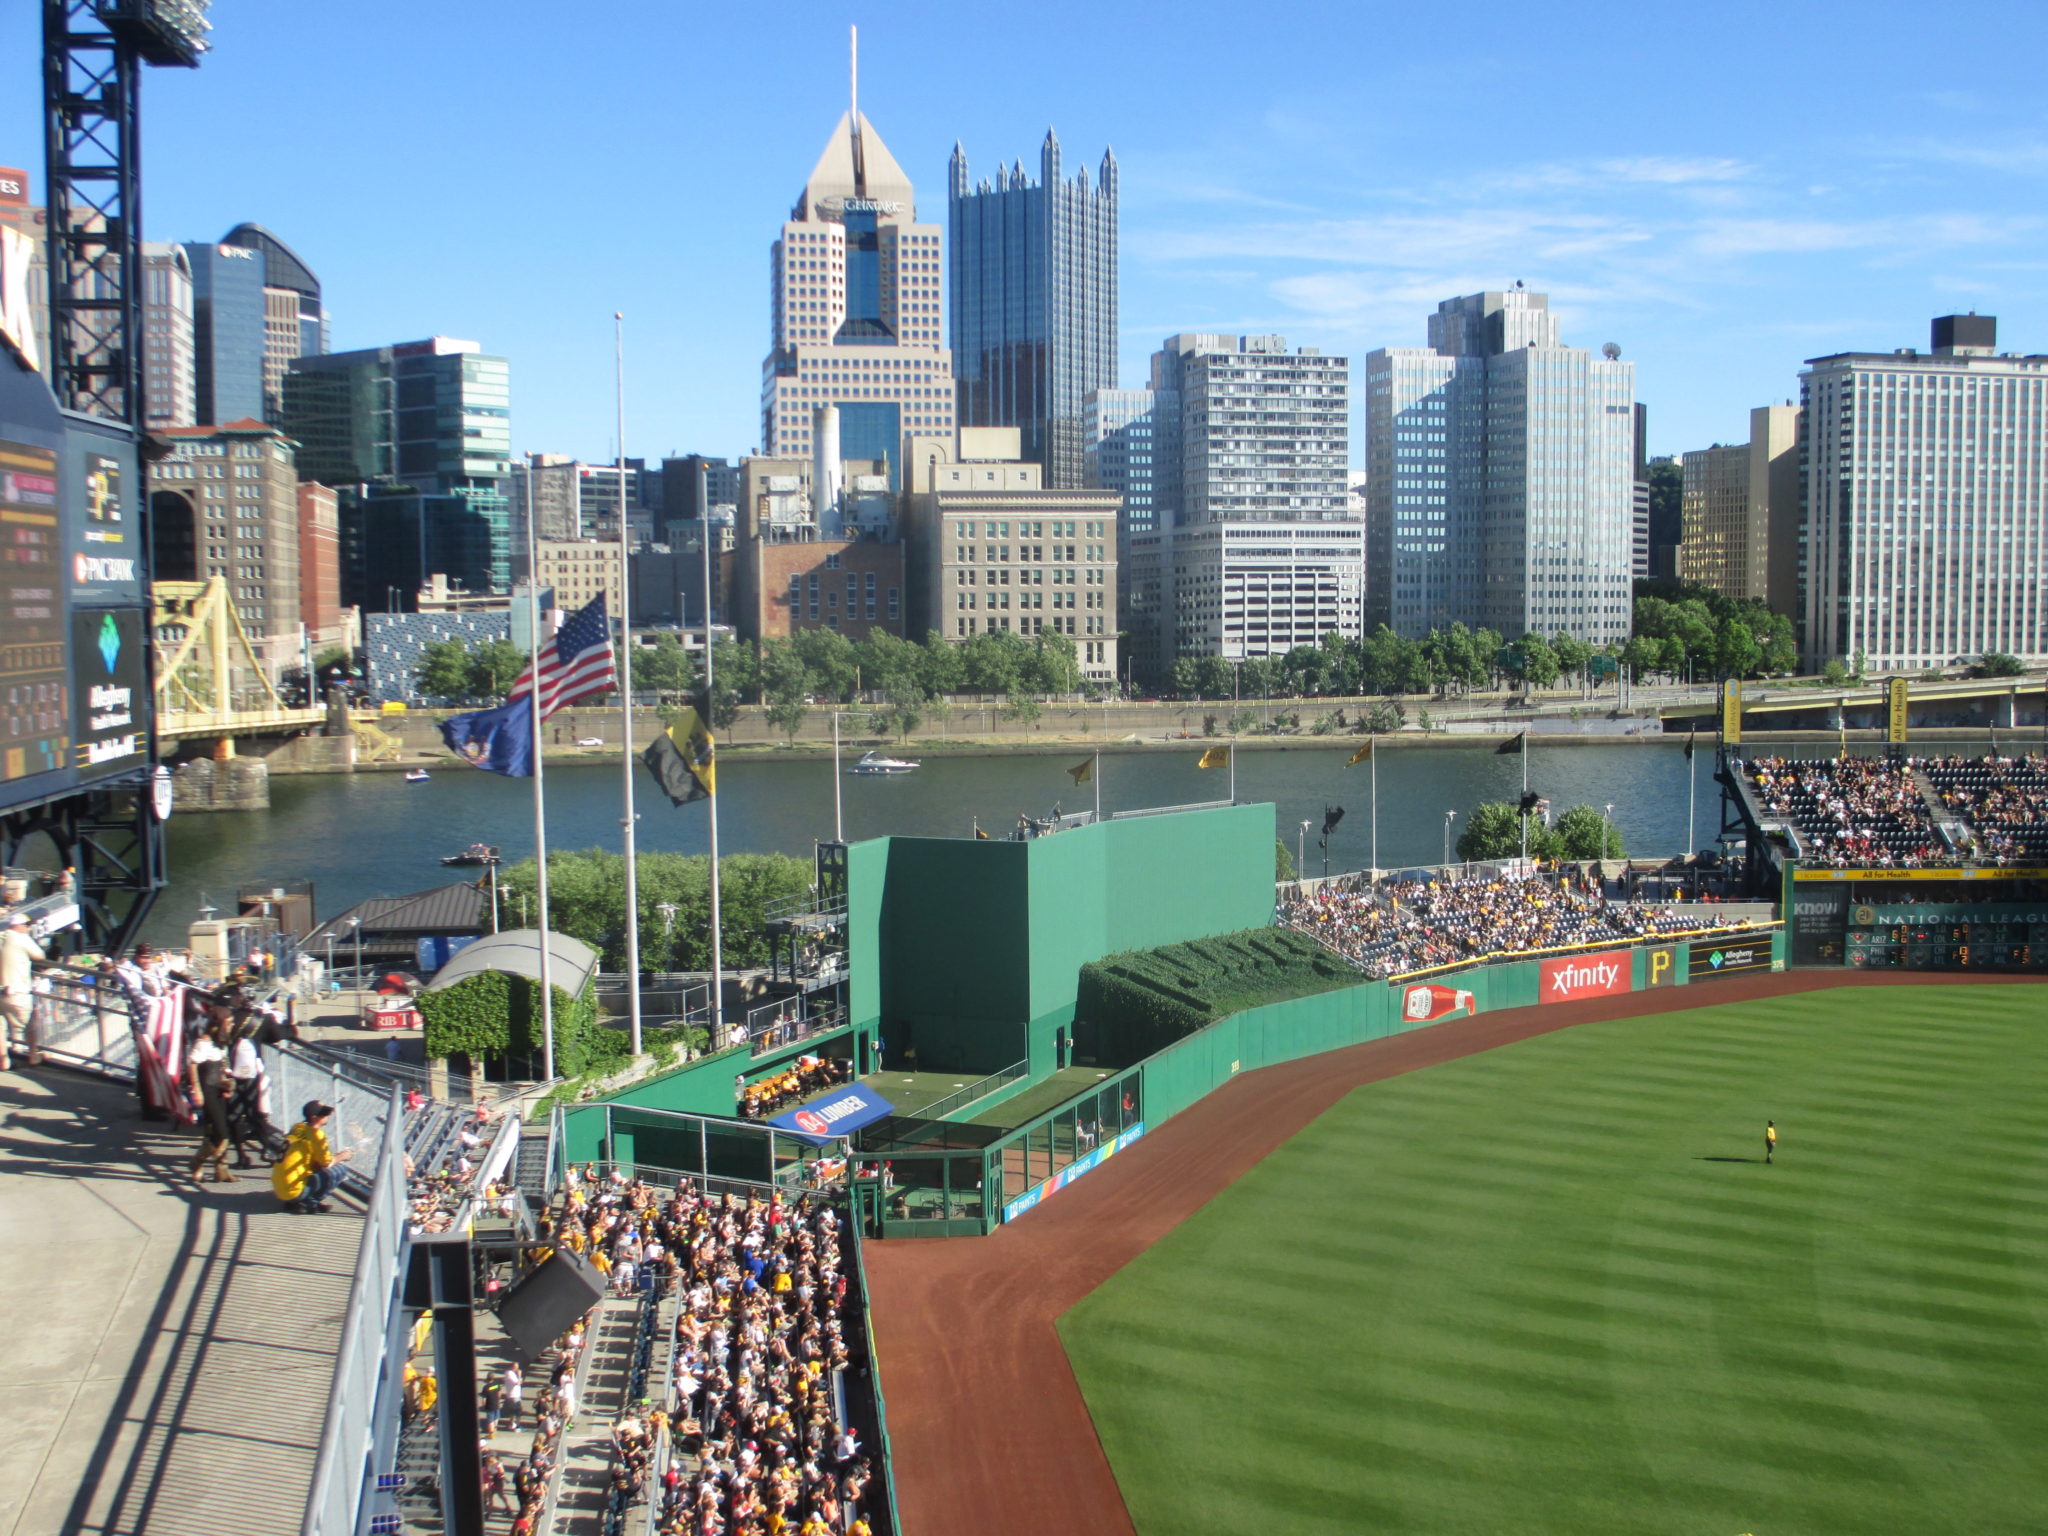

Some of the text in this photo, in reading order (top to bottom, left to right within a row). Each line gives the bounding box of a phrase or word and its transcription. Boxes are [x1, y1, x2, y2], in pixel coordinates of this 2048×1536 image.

[1894, 683, 1903, 712] Health
[1887, 870, 1911, 878] Health
[1879, 914, 1981, 924] NATIONAL
[1725, 950, 1753, 959] Allegheny
[1652, 951, 1669, 984] P
[1552, 961, 1619, 994] xfinity
[377, 1016, 397, 1026] RIB
[799, 1095, 868, 1132] 84 LUMBER
[1019, 1193, 1036, 1211] PAINTS
